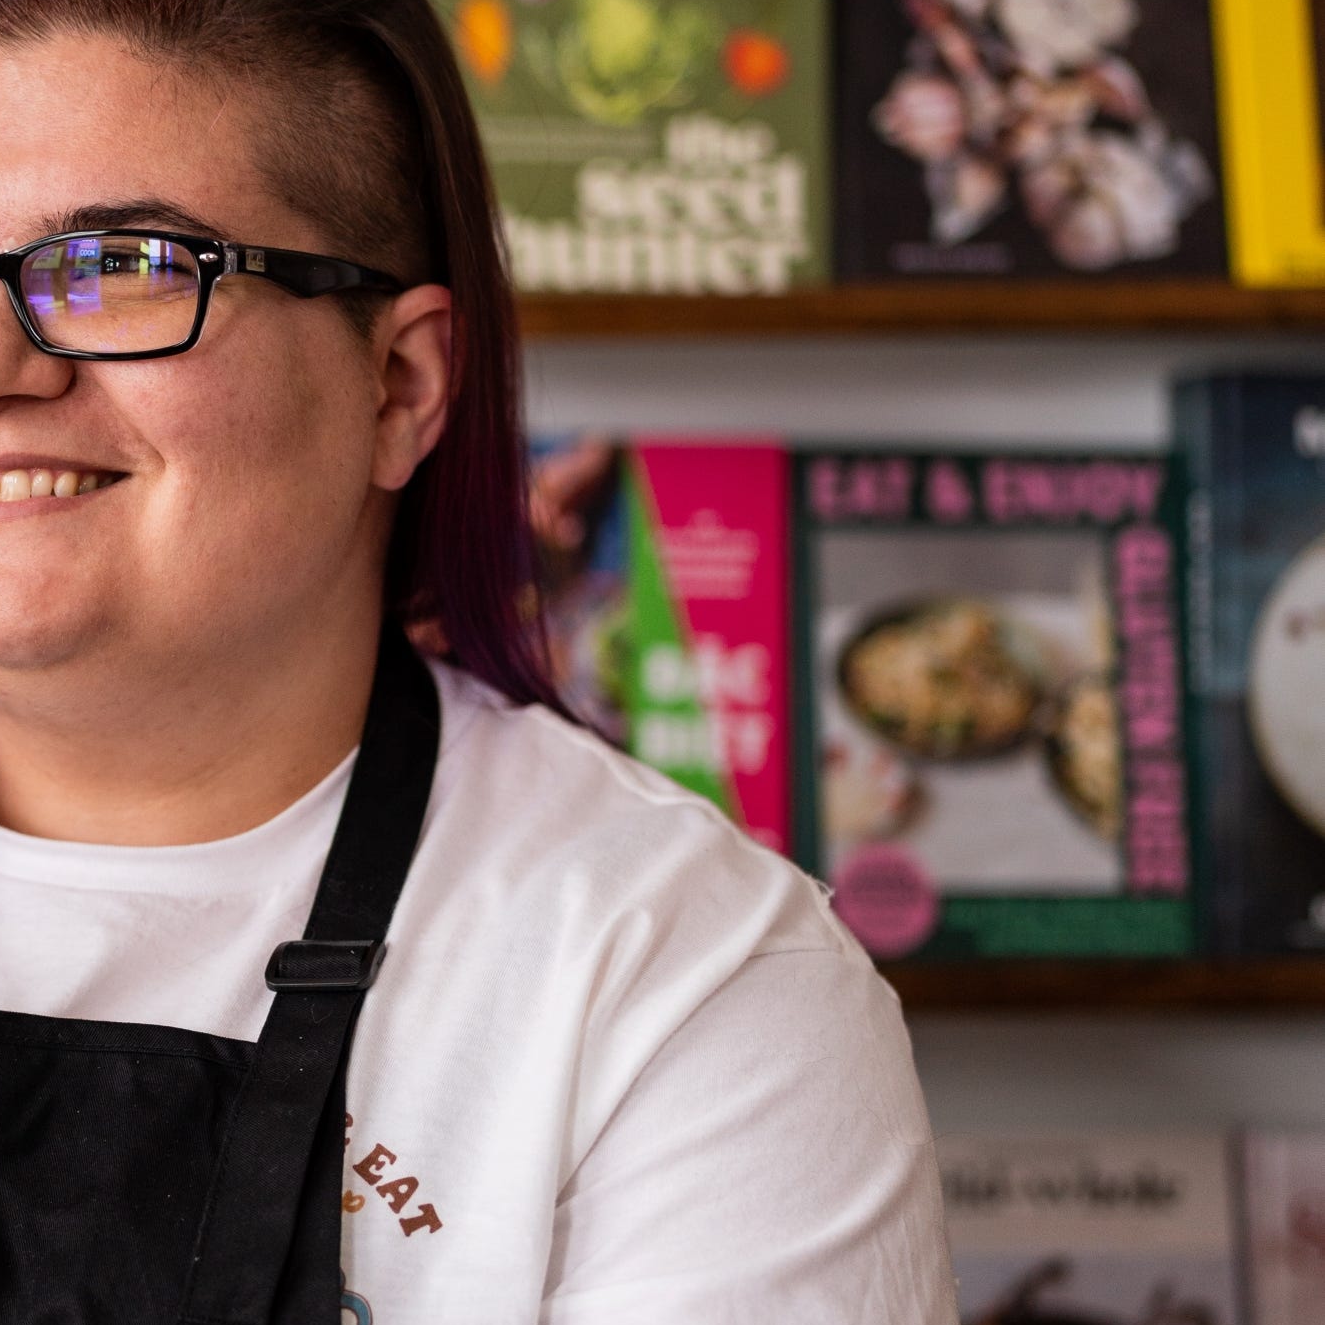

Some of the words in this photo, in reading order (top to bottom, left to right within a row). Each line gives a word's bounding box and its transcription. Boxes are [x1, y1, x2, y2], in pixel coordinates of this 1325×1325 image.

[811, 461, 911, 518] EAT
[927, 461, 973, 518] &
[985, 461, 1160, 518] ENJOY
[353, 1142, 443, 1237] EAT
